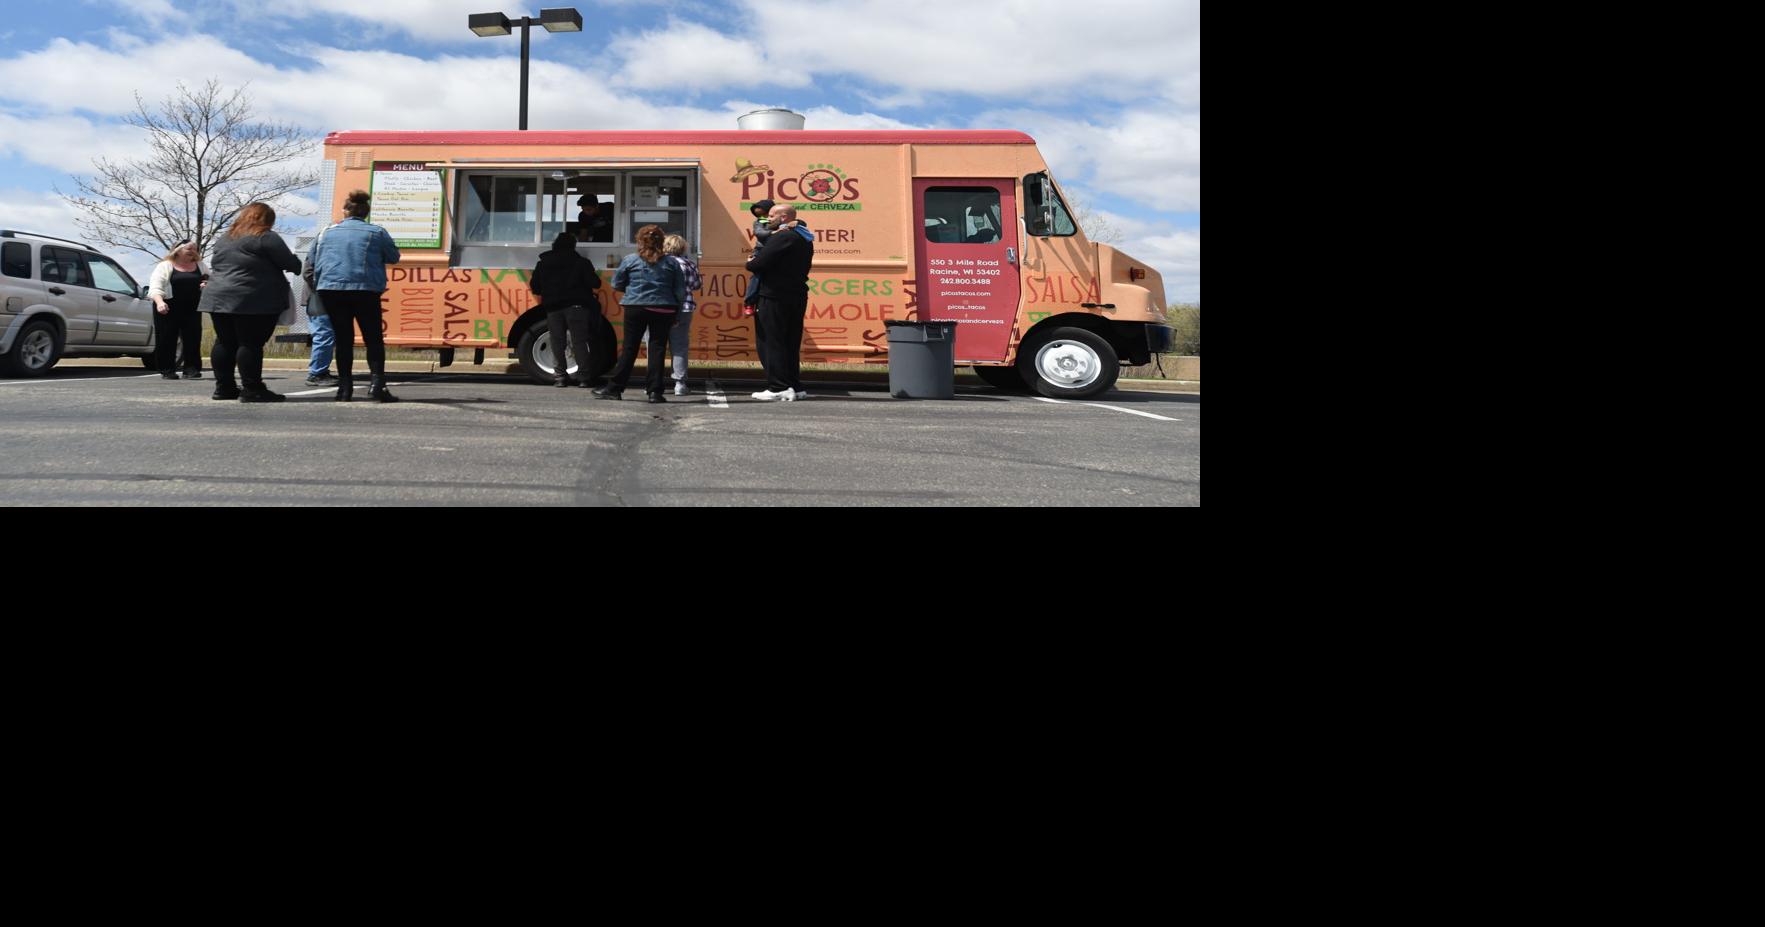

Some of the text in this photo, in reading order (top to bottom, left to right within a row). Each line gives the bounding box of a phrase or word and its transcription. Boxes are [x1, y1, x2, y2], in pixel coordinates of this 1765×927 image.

[393, 163, 424, 171] MENU
[810, 203, 855, 211] CERVEZA
[814, 229, 855, 243] TER!
[391, 266, 472, 283] DILLAS
[929, 268, 961, 276] Racine,
[808, 278, 893, 296] RGERS
[1026, 275, 1101, 304] SALSA
[442, 290, 469, 346] SALS
